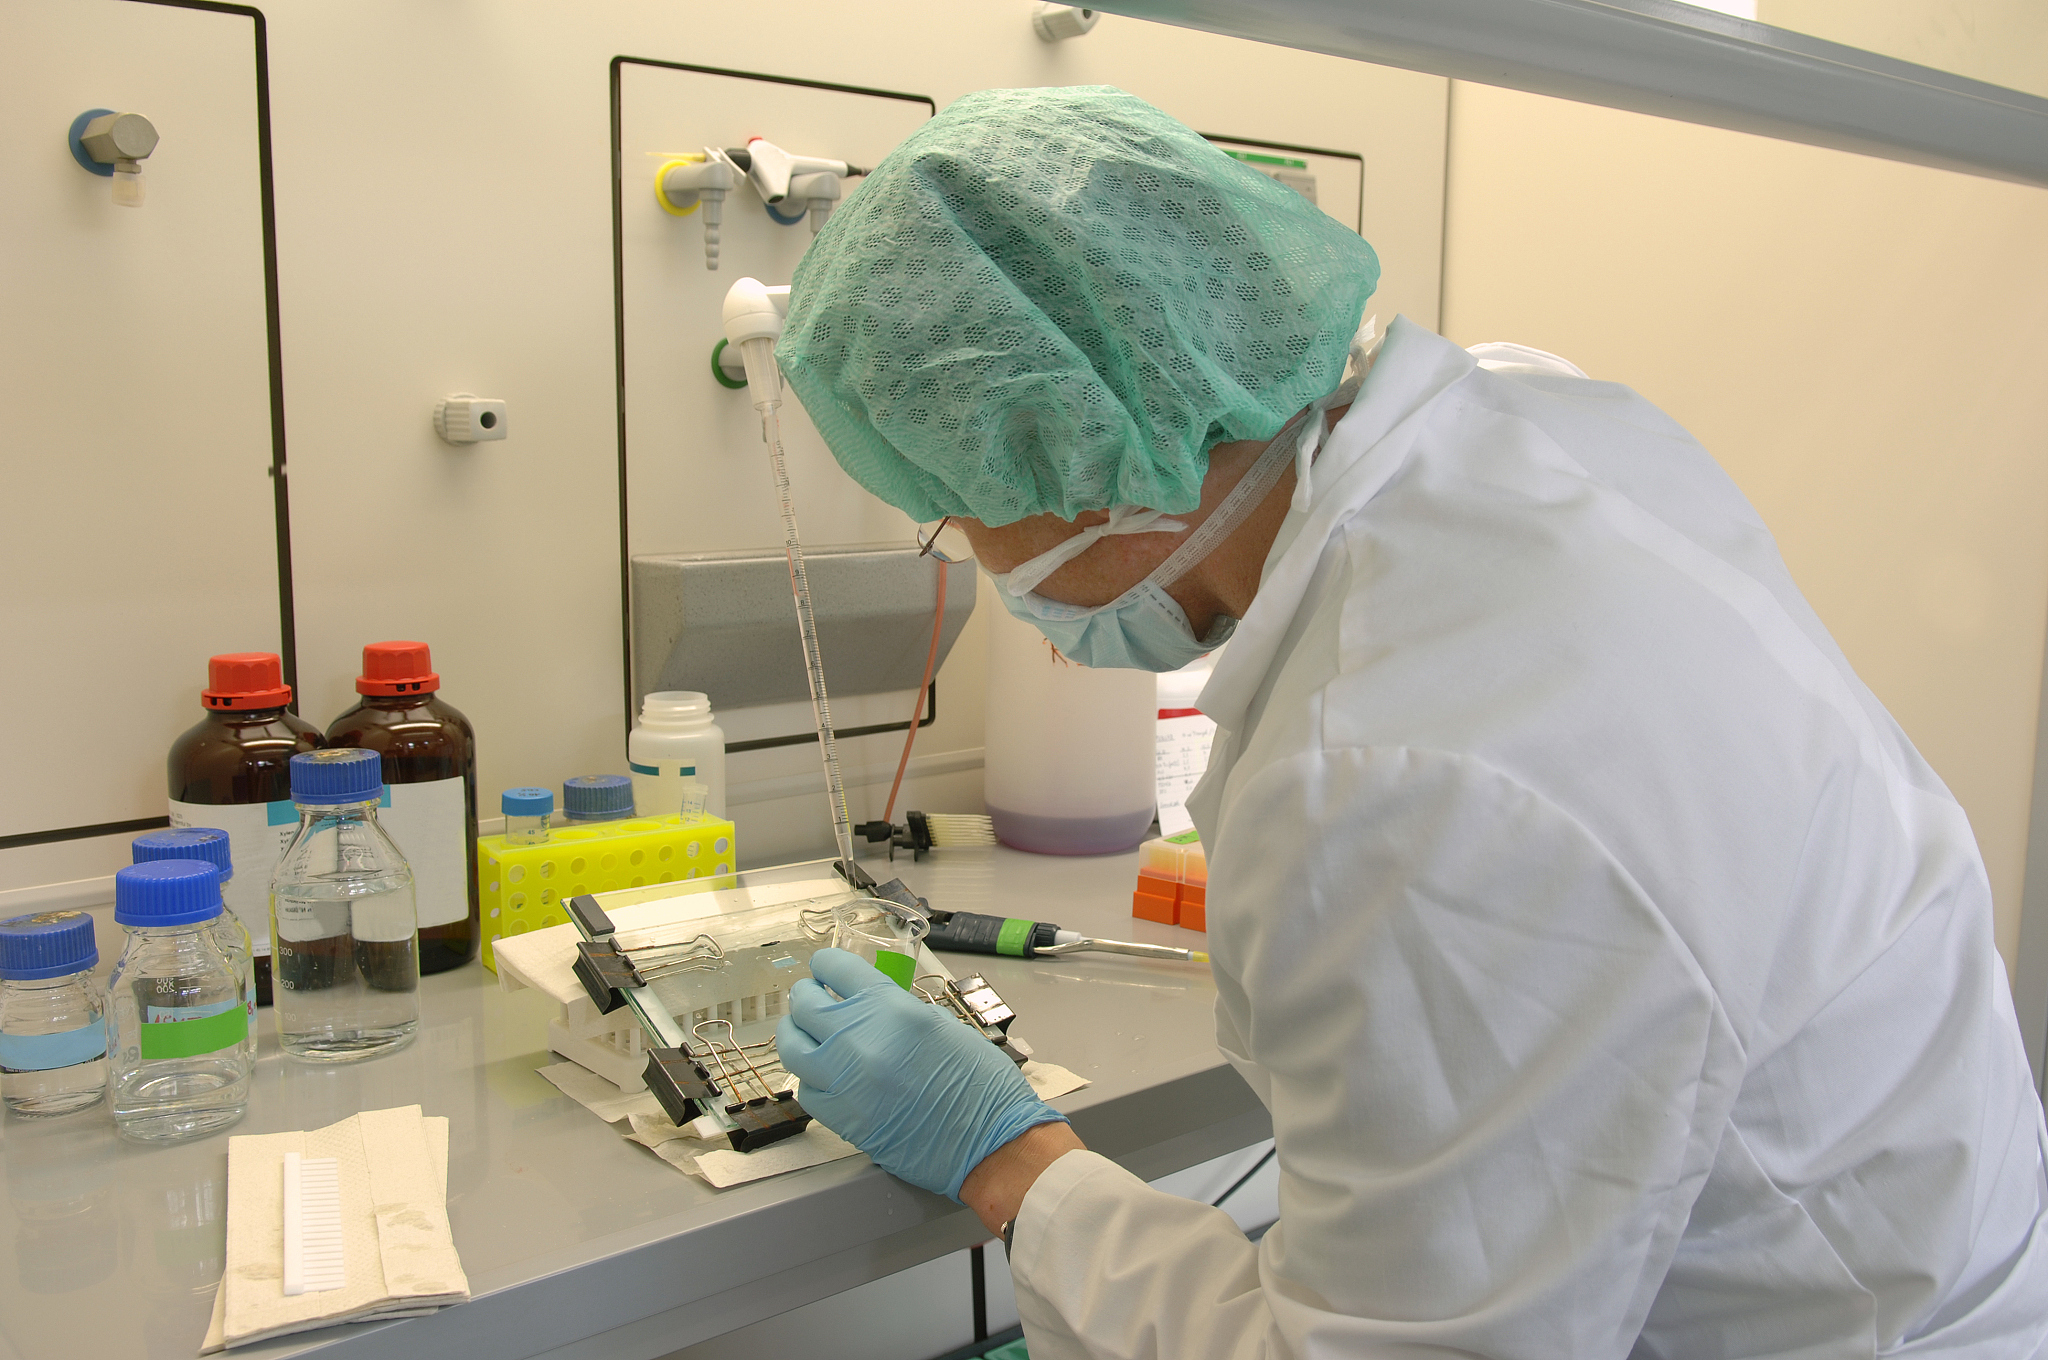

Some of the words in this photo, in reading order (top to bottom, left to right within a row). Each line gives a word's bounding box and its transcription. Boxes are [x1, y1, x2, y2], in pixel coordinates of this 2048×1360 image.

[279, 946, 293, 957] 300
[281, 979, 295, 990] 200
[284, 1012, 297, 1022] 100
